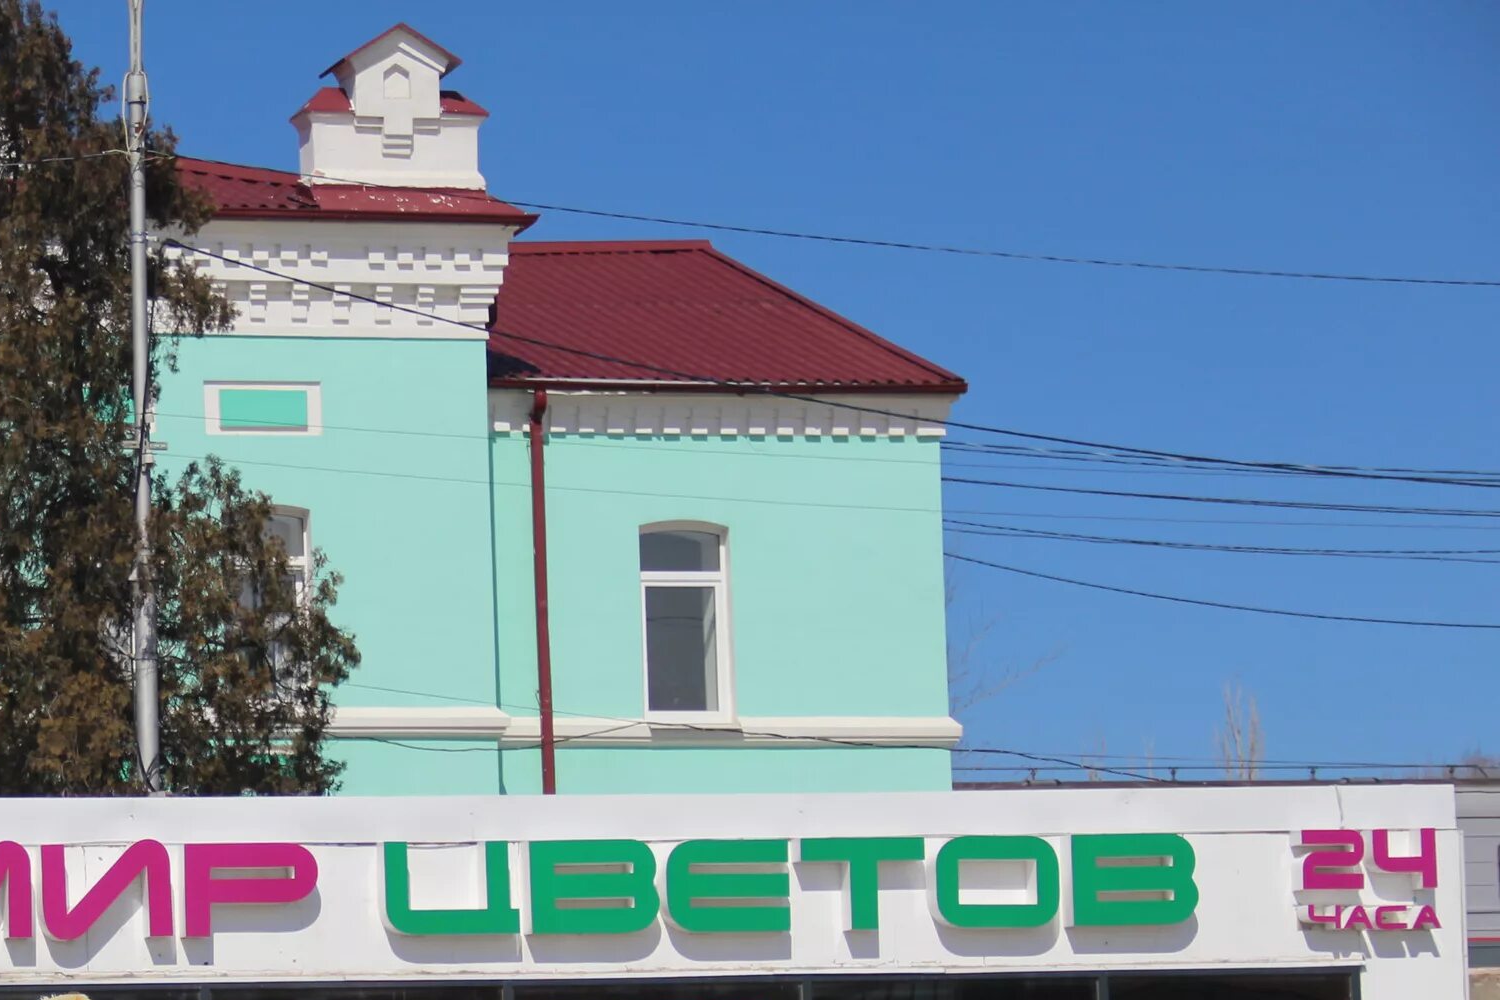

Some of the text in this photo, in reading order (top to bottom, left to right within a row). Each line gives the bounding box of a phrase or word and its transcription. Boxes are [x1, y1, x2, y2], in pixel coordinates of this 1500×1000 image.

[384, 833, 1199, 935] ЦВЕТОВ
[1300, 828, 1438, 889] 24
[1308, 904, 1443, 929] ЧАСА
